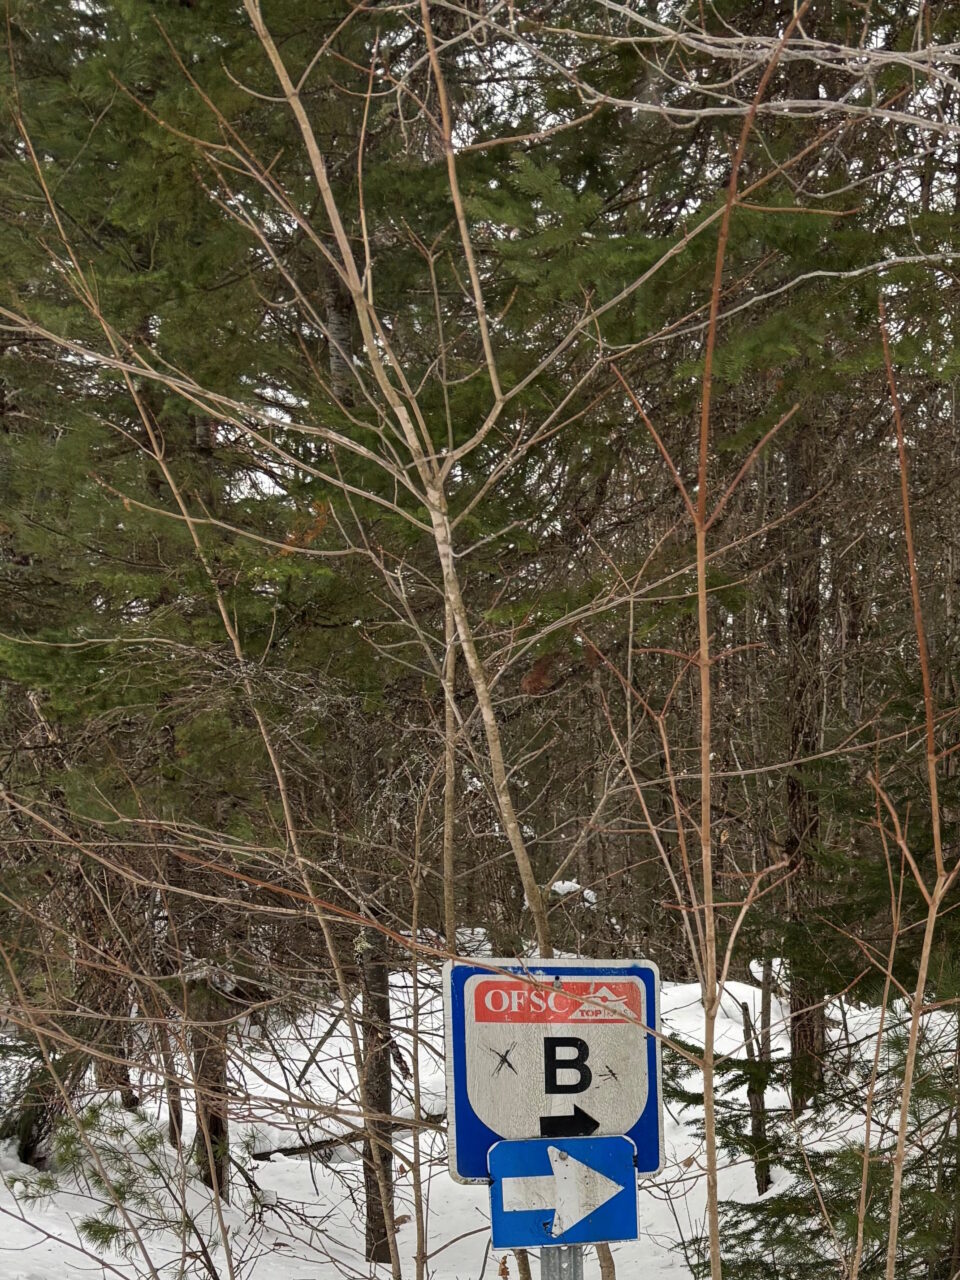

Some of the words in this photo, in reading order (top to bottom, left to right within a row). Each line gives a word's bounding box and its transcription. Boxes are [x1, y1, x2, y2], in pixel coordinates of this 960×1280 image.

[484, 989, 569, 1013] OFSC
[578, 1009, 602, 1018] TOP
[544, 1036, 593, 1095] B
